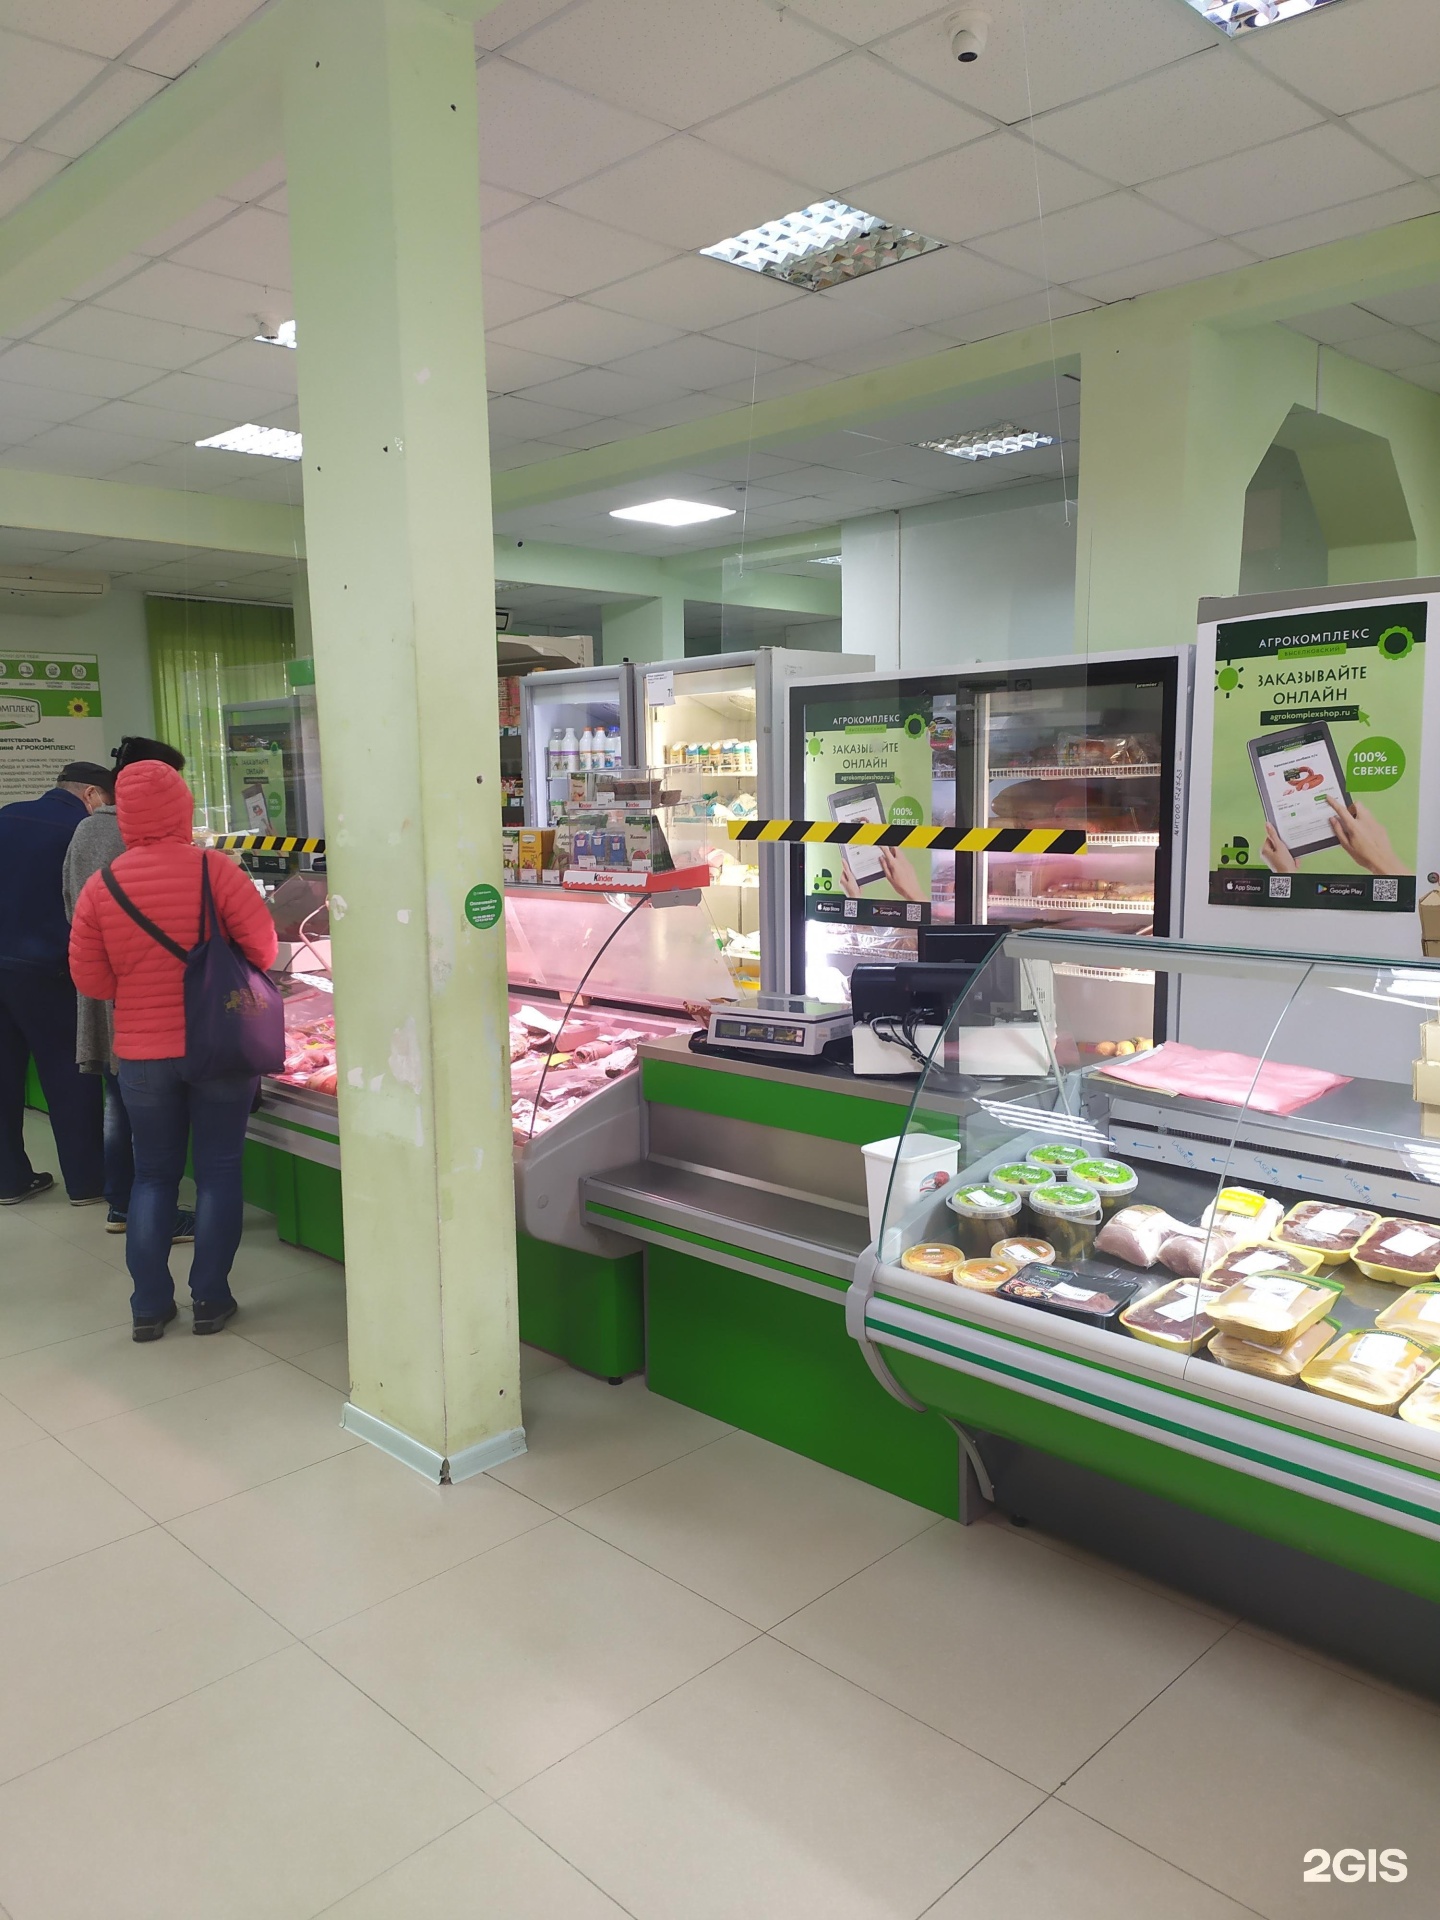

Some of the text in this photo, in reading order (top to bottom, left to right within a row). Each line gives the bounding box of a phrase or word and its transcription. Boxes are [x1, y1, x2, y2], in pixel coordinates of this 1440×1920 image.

[1258, 628, 1370, 649] АГРОКОМПЛЕКС
[1257, 665, 1367, 687] ЗАКАЗЫВАЙТЕ
[1273, 686, 1347, 705] ОНЛАЙН
[832, 714, 900, 725] АГРОКОМПЛЕКС
[1269, 709, 1351, 722] agrokomplexshop.ru
[842, 756, 888, 769] ОНЛАЙН
[1353, 751, 1387, 764] 100%
[1352, 765, 1398, 776] СВЕЖЕЕ
[892, 807, 913, 816] 100%
[892, 818, 919, 826] СВЕЖЕЕ
[593, 873, 614, 882] Kinder
[1329, 887, 1363, 896] Google Play
